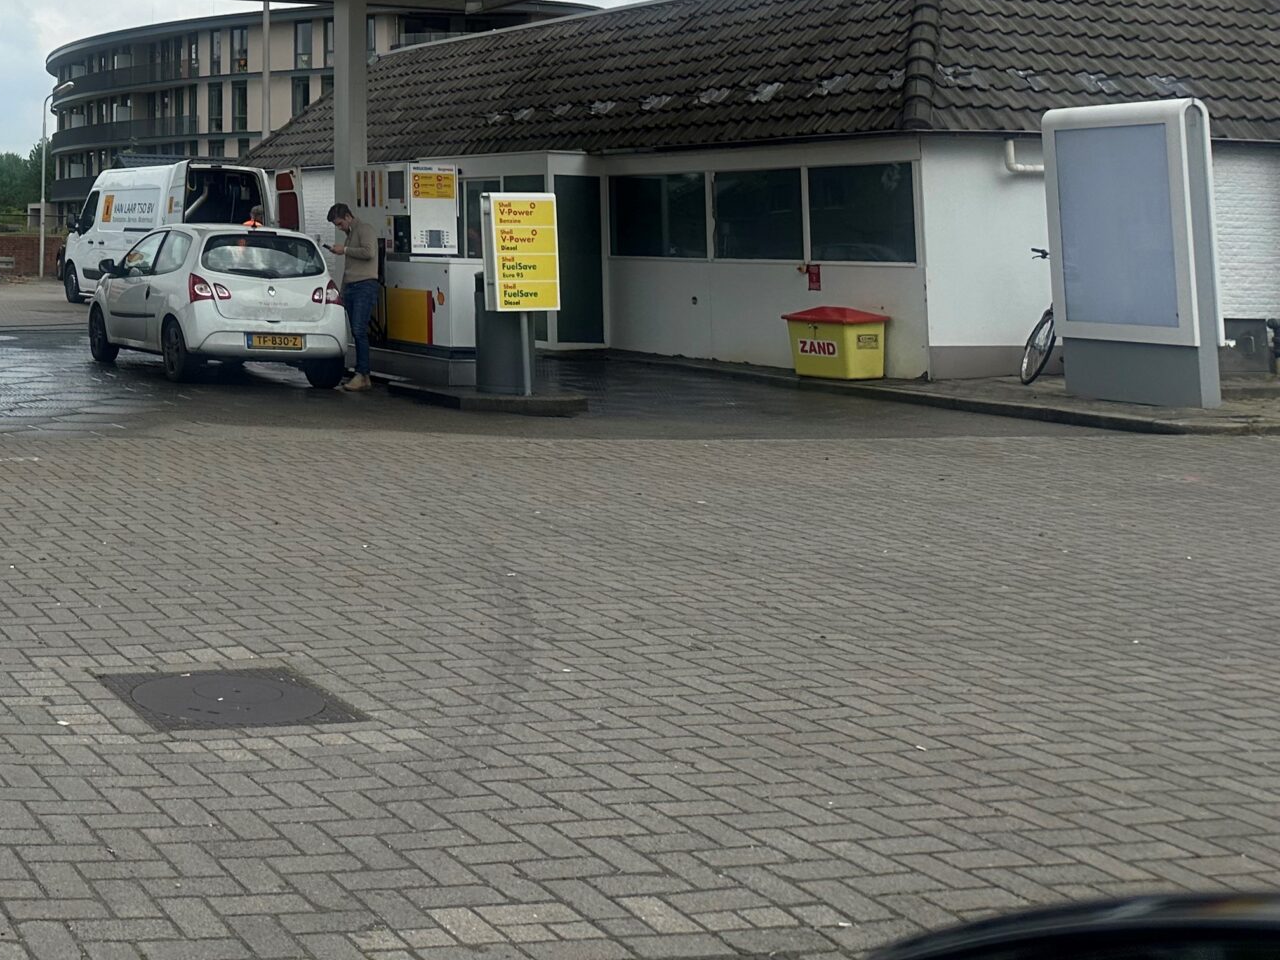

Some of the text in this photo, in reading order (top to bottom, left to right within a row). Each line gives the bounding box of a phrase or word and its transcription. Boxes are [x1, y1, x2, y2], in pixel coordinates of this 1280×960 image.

[124, 203, 137, 214] LAAR
[148, 203, 155, 214] BV
[257, 336, 298, 346] TF-830-Z
[800, 340, 836, 356] ZAND
